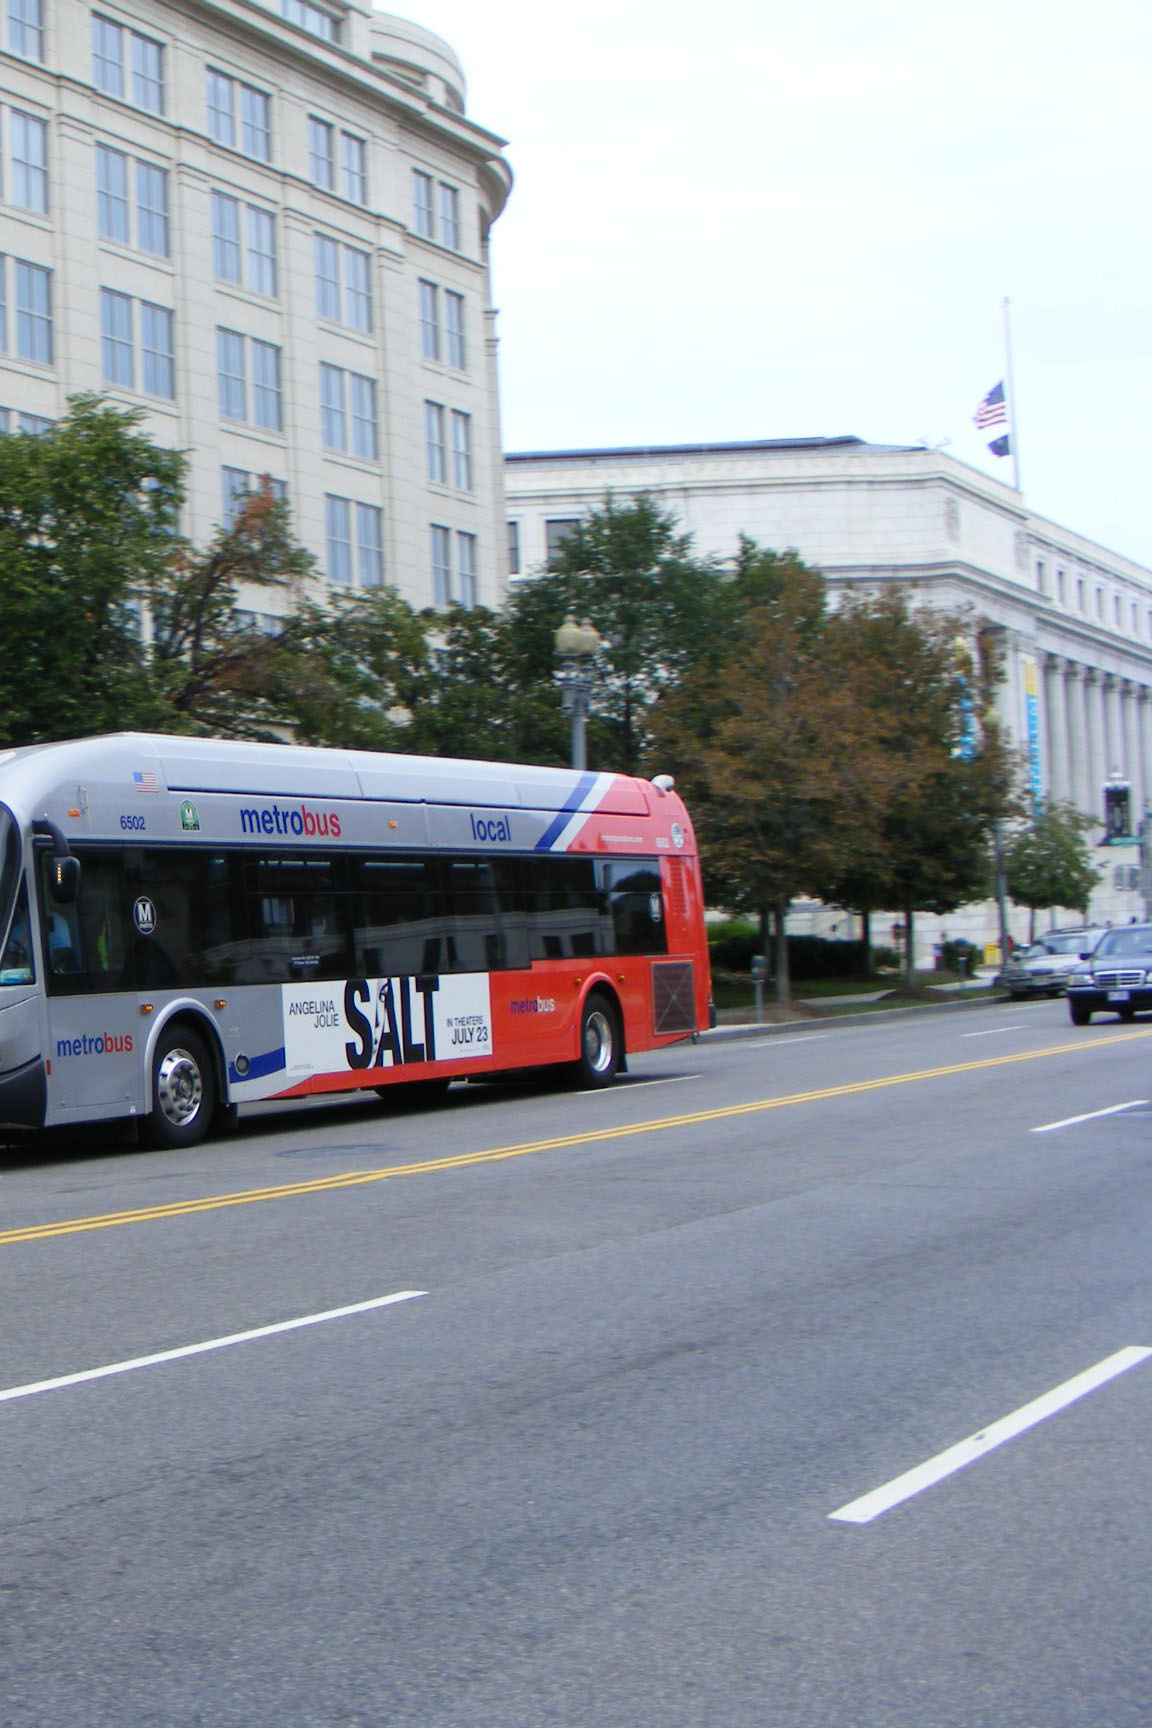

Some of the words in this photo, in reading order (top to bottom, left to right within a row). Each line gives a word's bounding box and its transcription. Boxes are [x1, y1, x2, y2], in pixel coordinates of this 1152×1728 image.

[120, 815, 145, 830] 6502
[240, 804, 341, 837] metrobus
[470, 813, 511, 841] local
[138, 902, 152, 922] M
[289, 1000, 335, 1016] ANGELINA
[510, 995, 555, 1013] metrobus
[314, 1013, 339, 1028] JOLIE
[344, 975, 440, 1070] SALT
[454, 1015, 483, 1026] THEATERS
[56, 1032, 134, 1057] metrobus
[451, 1027, 474, 1045] JULY
[476, 1026, 488, 1042] 23
